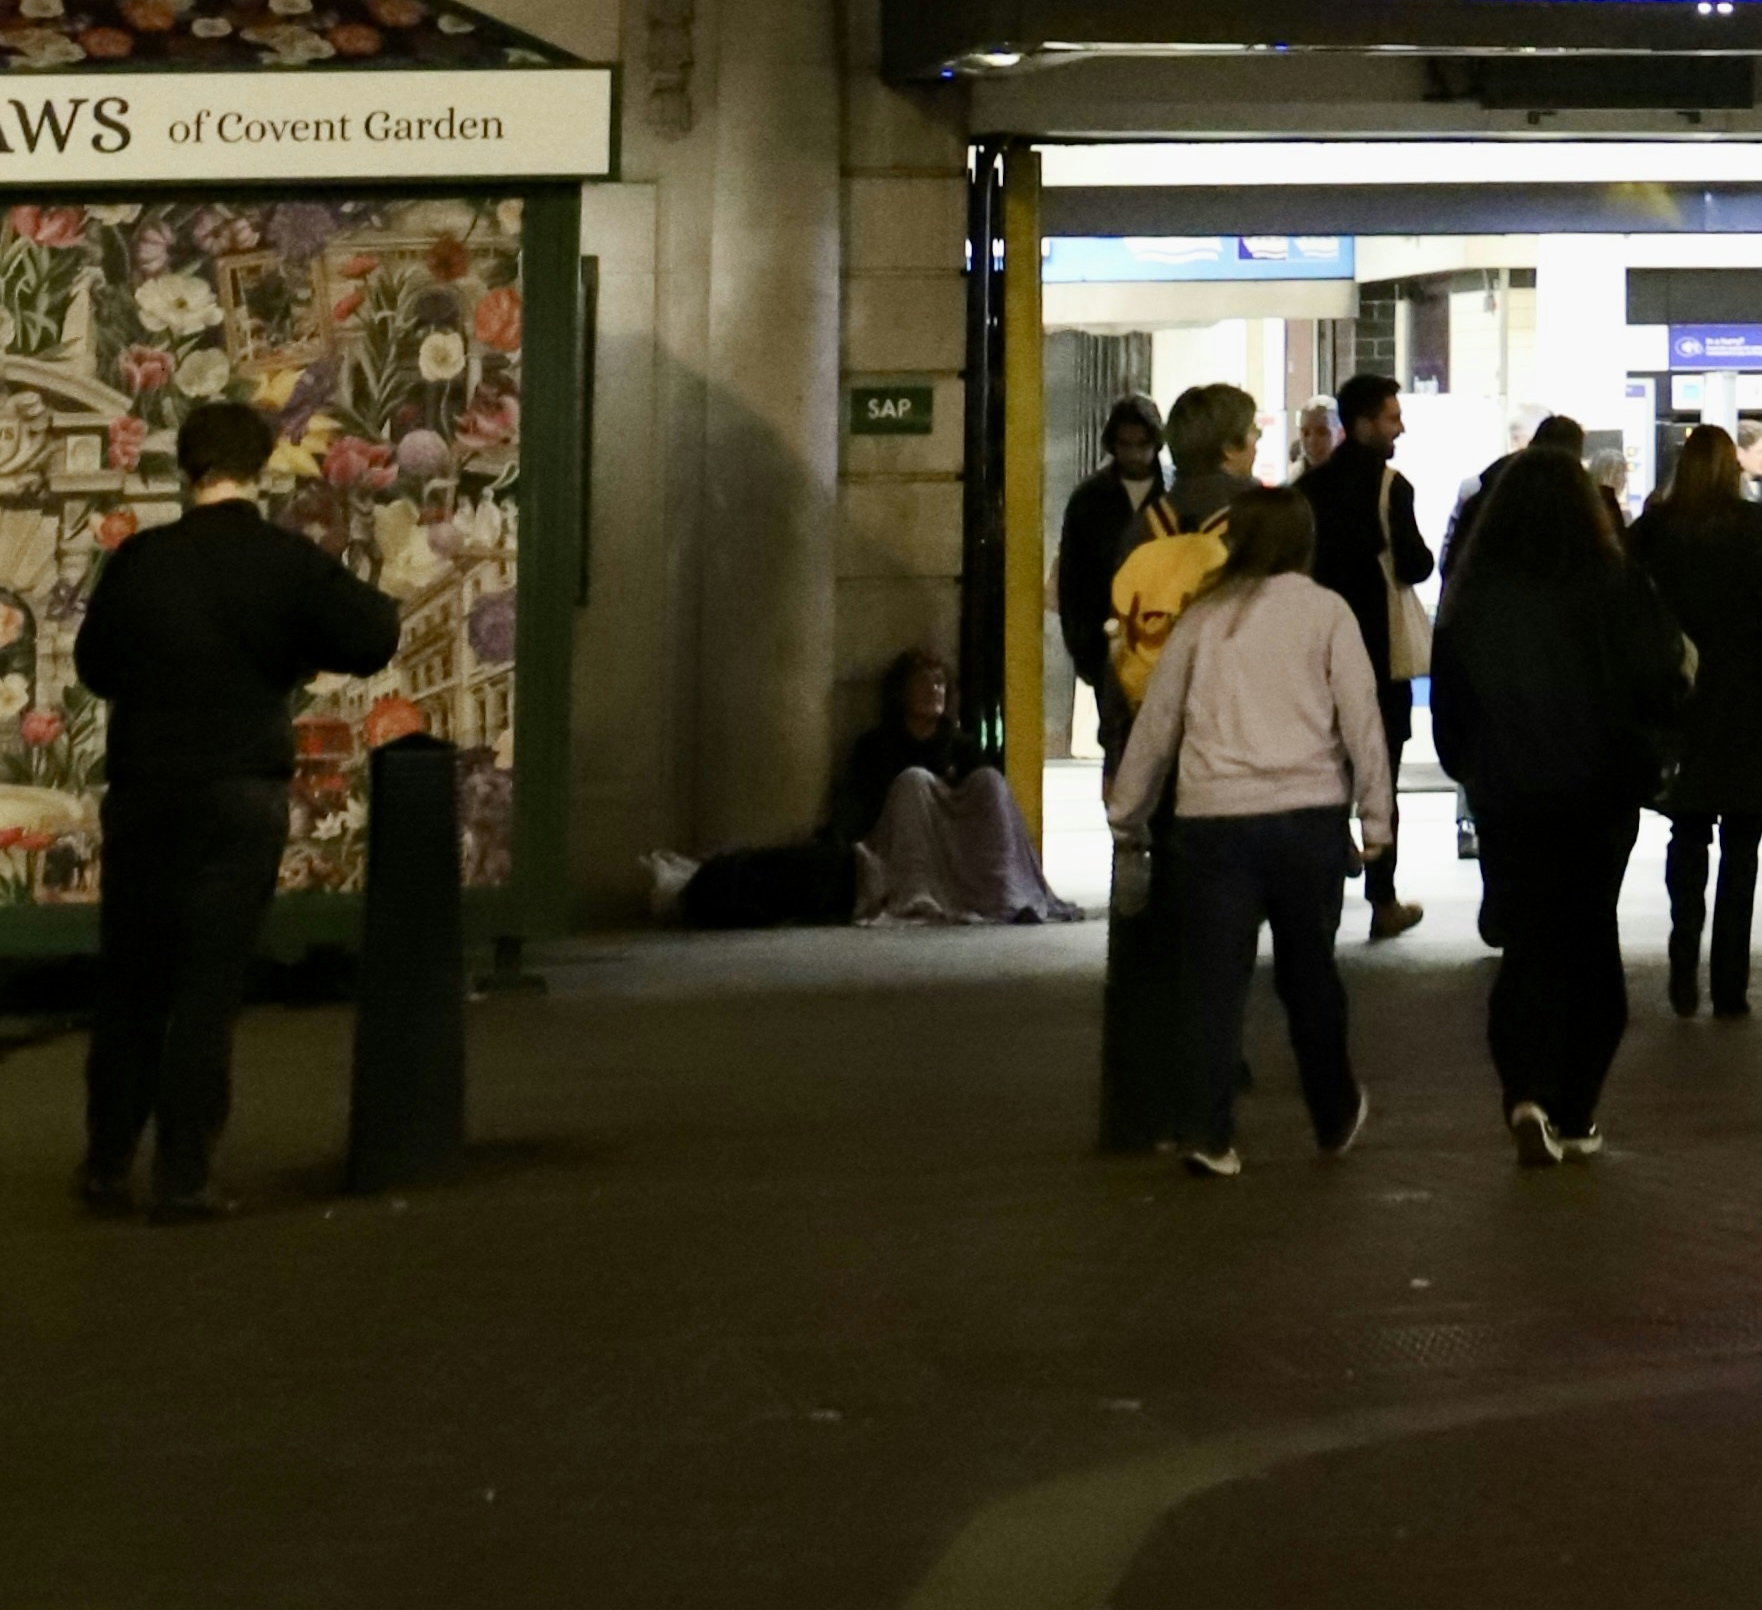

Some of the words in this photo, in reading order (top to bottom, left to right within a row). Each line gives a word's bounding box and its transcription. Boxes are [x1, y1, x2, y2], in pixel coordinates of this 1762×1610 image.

[0, 97, 131, 154] WS
[169, 109, 210, 143] of
[216, 111, 351, 143] Covent
[364, 107, 504, 142] Garden
[868, 397, 912, 420] SAP
